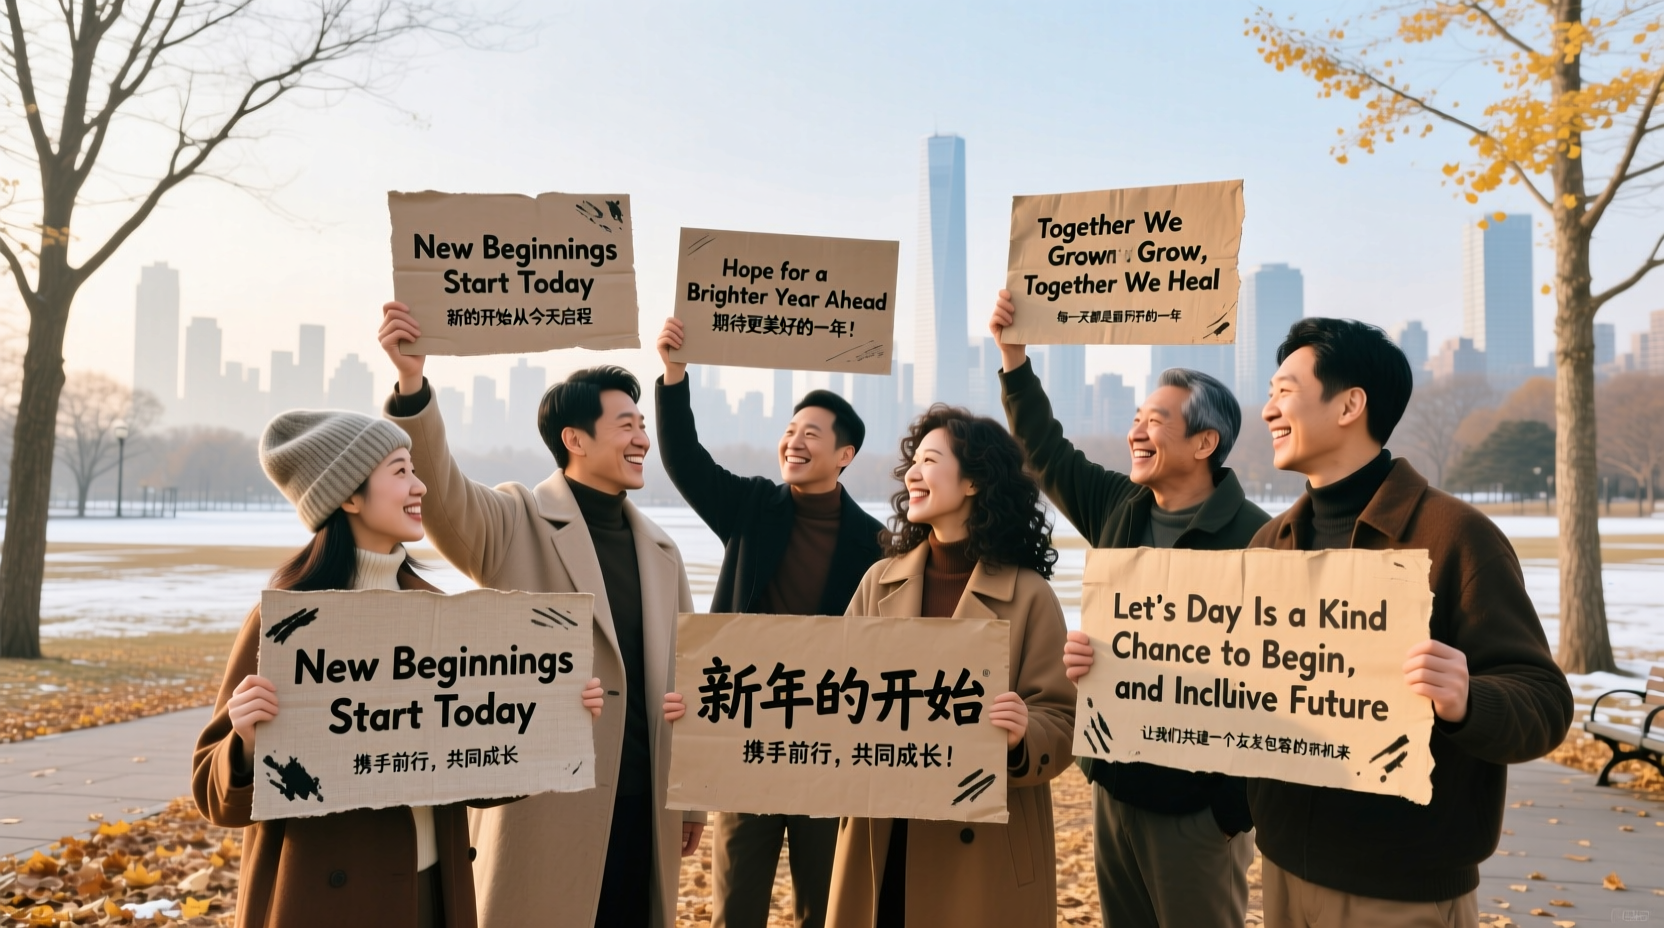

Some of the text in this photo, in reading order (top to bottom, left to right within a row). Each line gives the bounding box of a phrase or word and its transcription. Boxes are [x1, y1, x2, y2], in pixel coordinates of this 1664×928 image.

[1037, 209, 1183, 244] Together We
[413, 232, 618, 268] New Beginnings
[1137, 240, 1208, 265] Grow,
[443, 268, 595, 302] Start Today
[722, 257, 828, 286] Hope for a
[1023, 267, 1221, 302] Together We Heal
[686, 281, 888, 312] Brighter Year Ahead
[446, 306, 594, 328] 新的开始从今天启程
[711, 310, 856, 339] 期待更美好的一年！
[1114, 592, 1388, 634] Let's Day Is a Kind
[294, 643, 574, 689] New Beginnings
[1111, 630, 1356, 682] Chance to Begin,
[696, 655, 986, 732] 新年的开始
[1114, 674, 1164, 703] and
[1290, 684, 1390, 722] Future
[328, 691, 537, 735] Start Today
